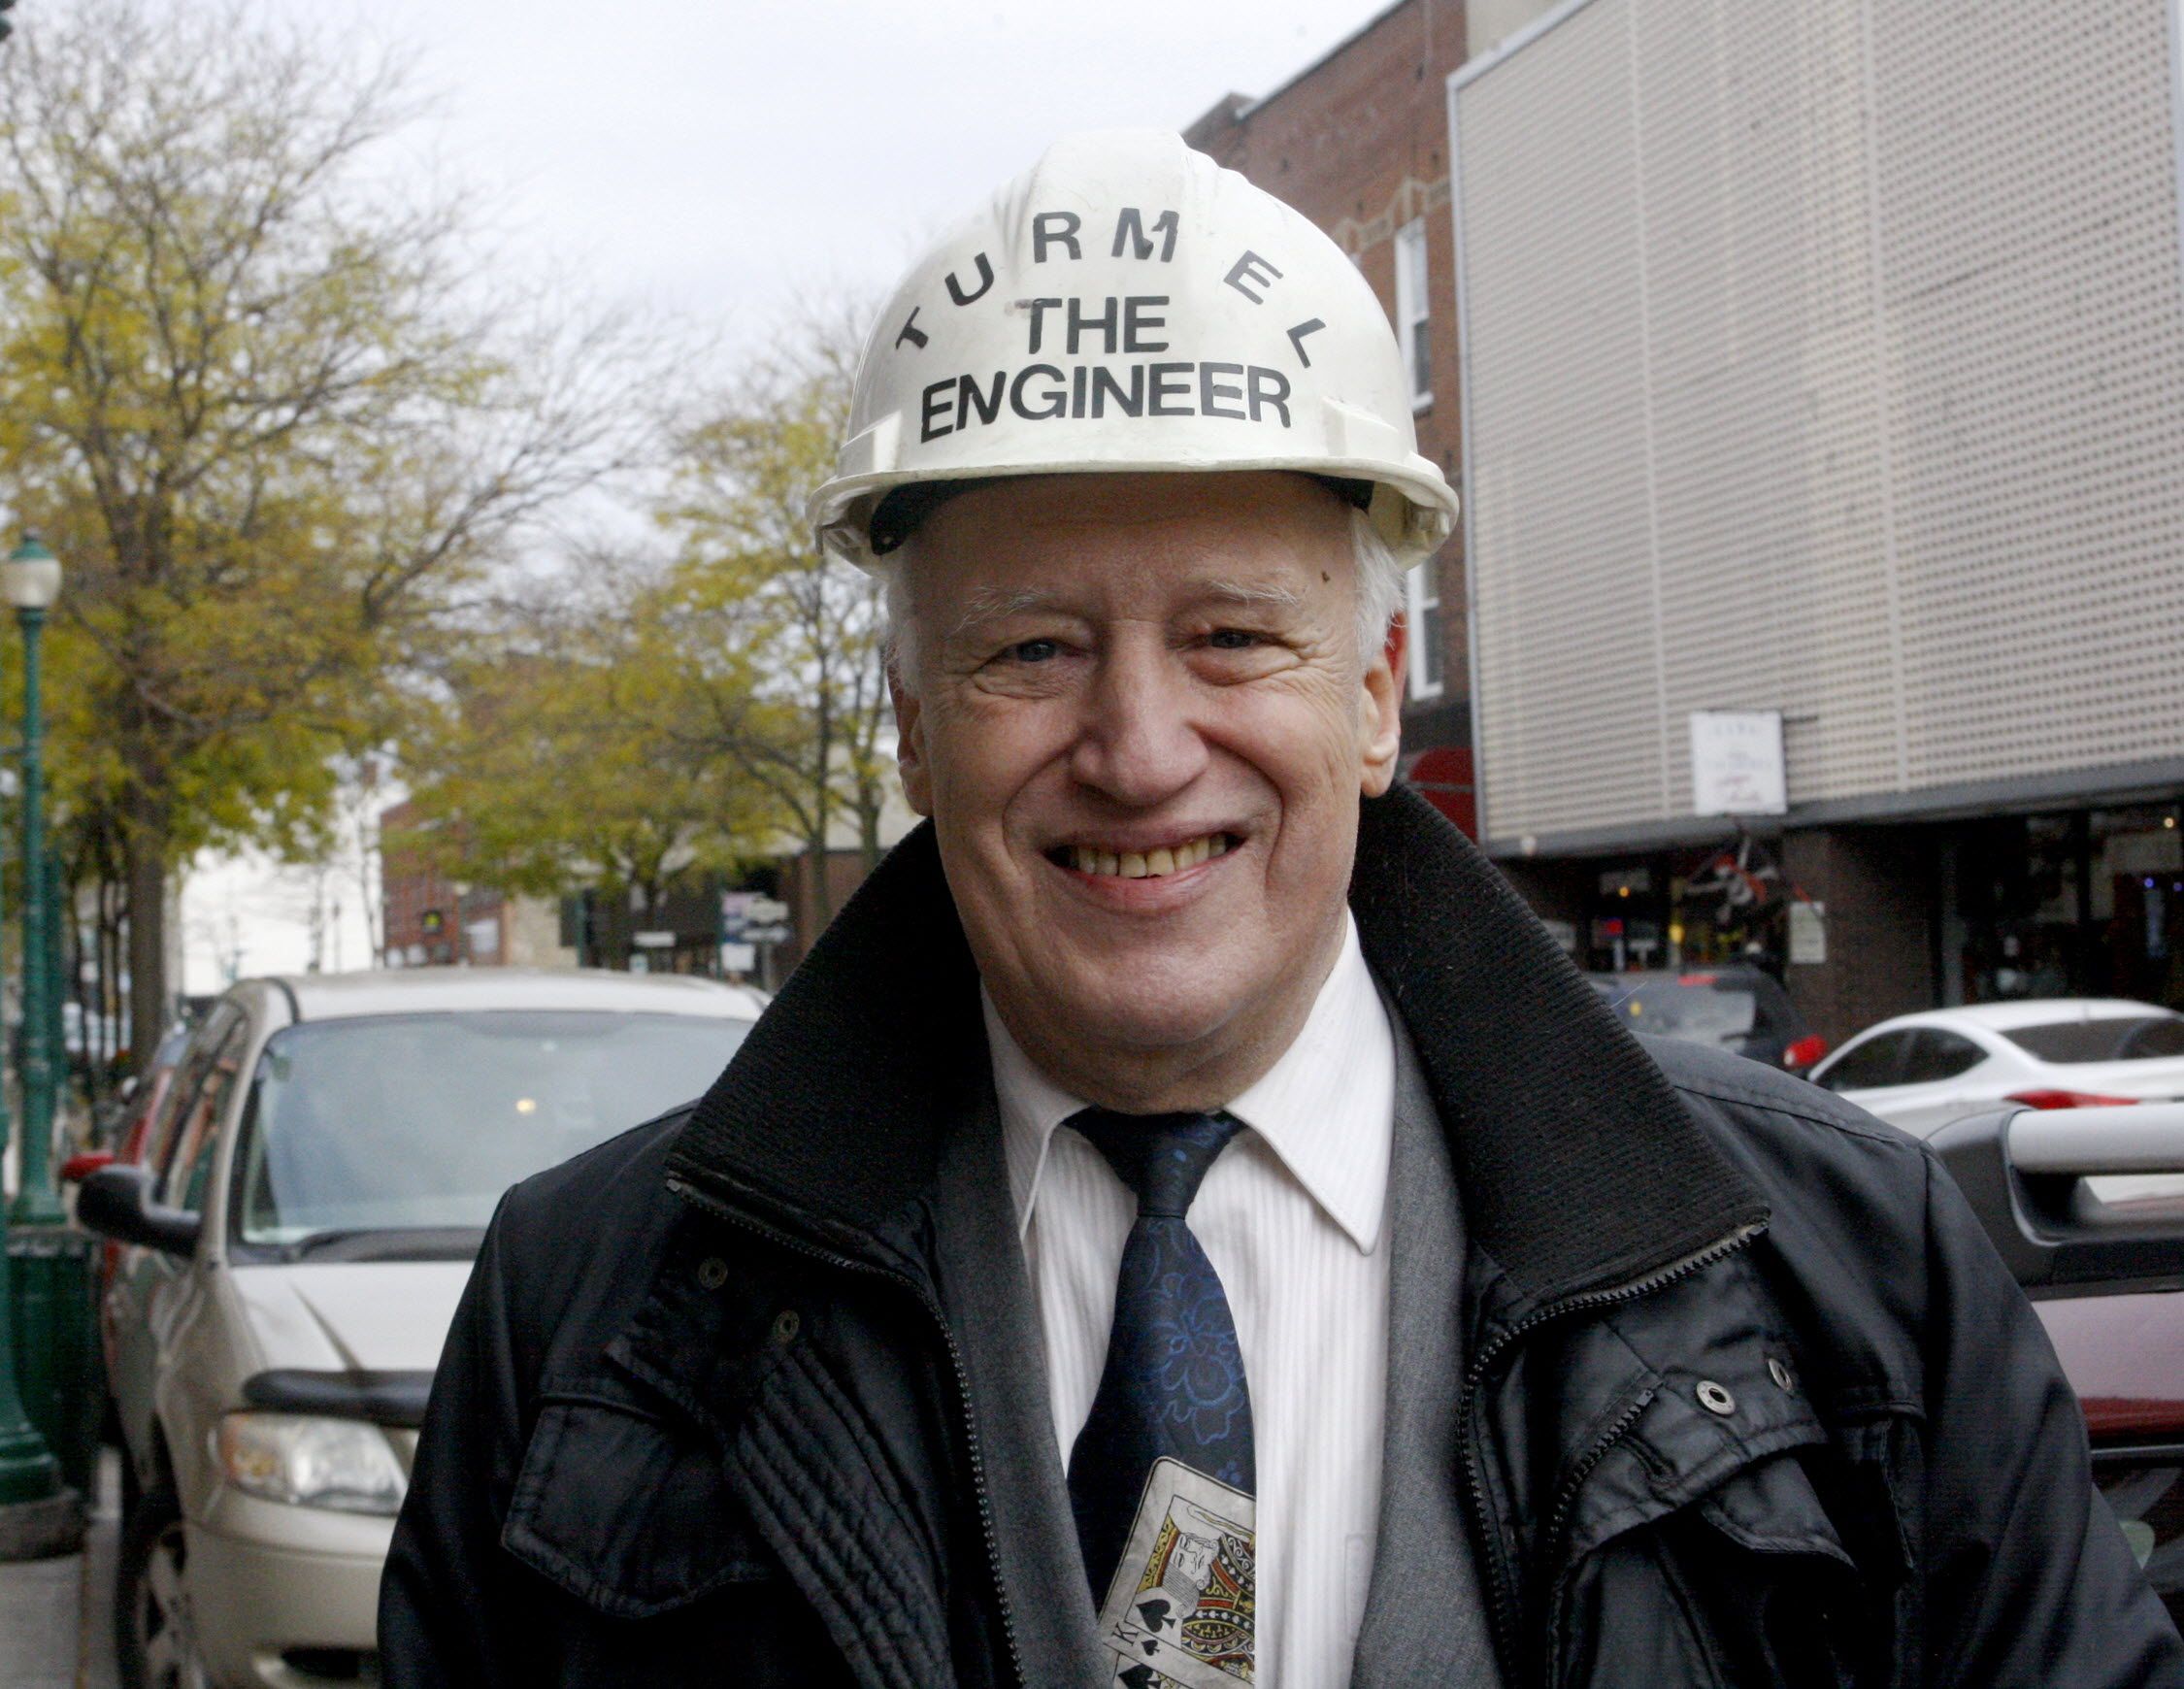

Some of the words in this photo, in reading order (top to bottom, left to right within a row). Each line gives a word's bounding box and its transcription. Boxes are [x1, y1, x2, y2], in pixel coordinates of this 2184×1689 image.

[895, 207, 1327, 369] TURMEL
[1028, 296, 1170, 354] THE
[920, 363, 1291, 444] ENGINEER
[1111, 1622, 1139, 1646] K
